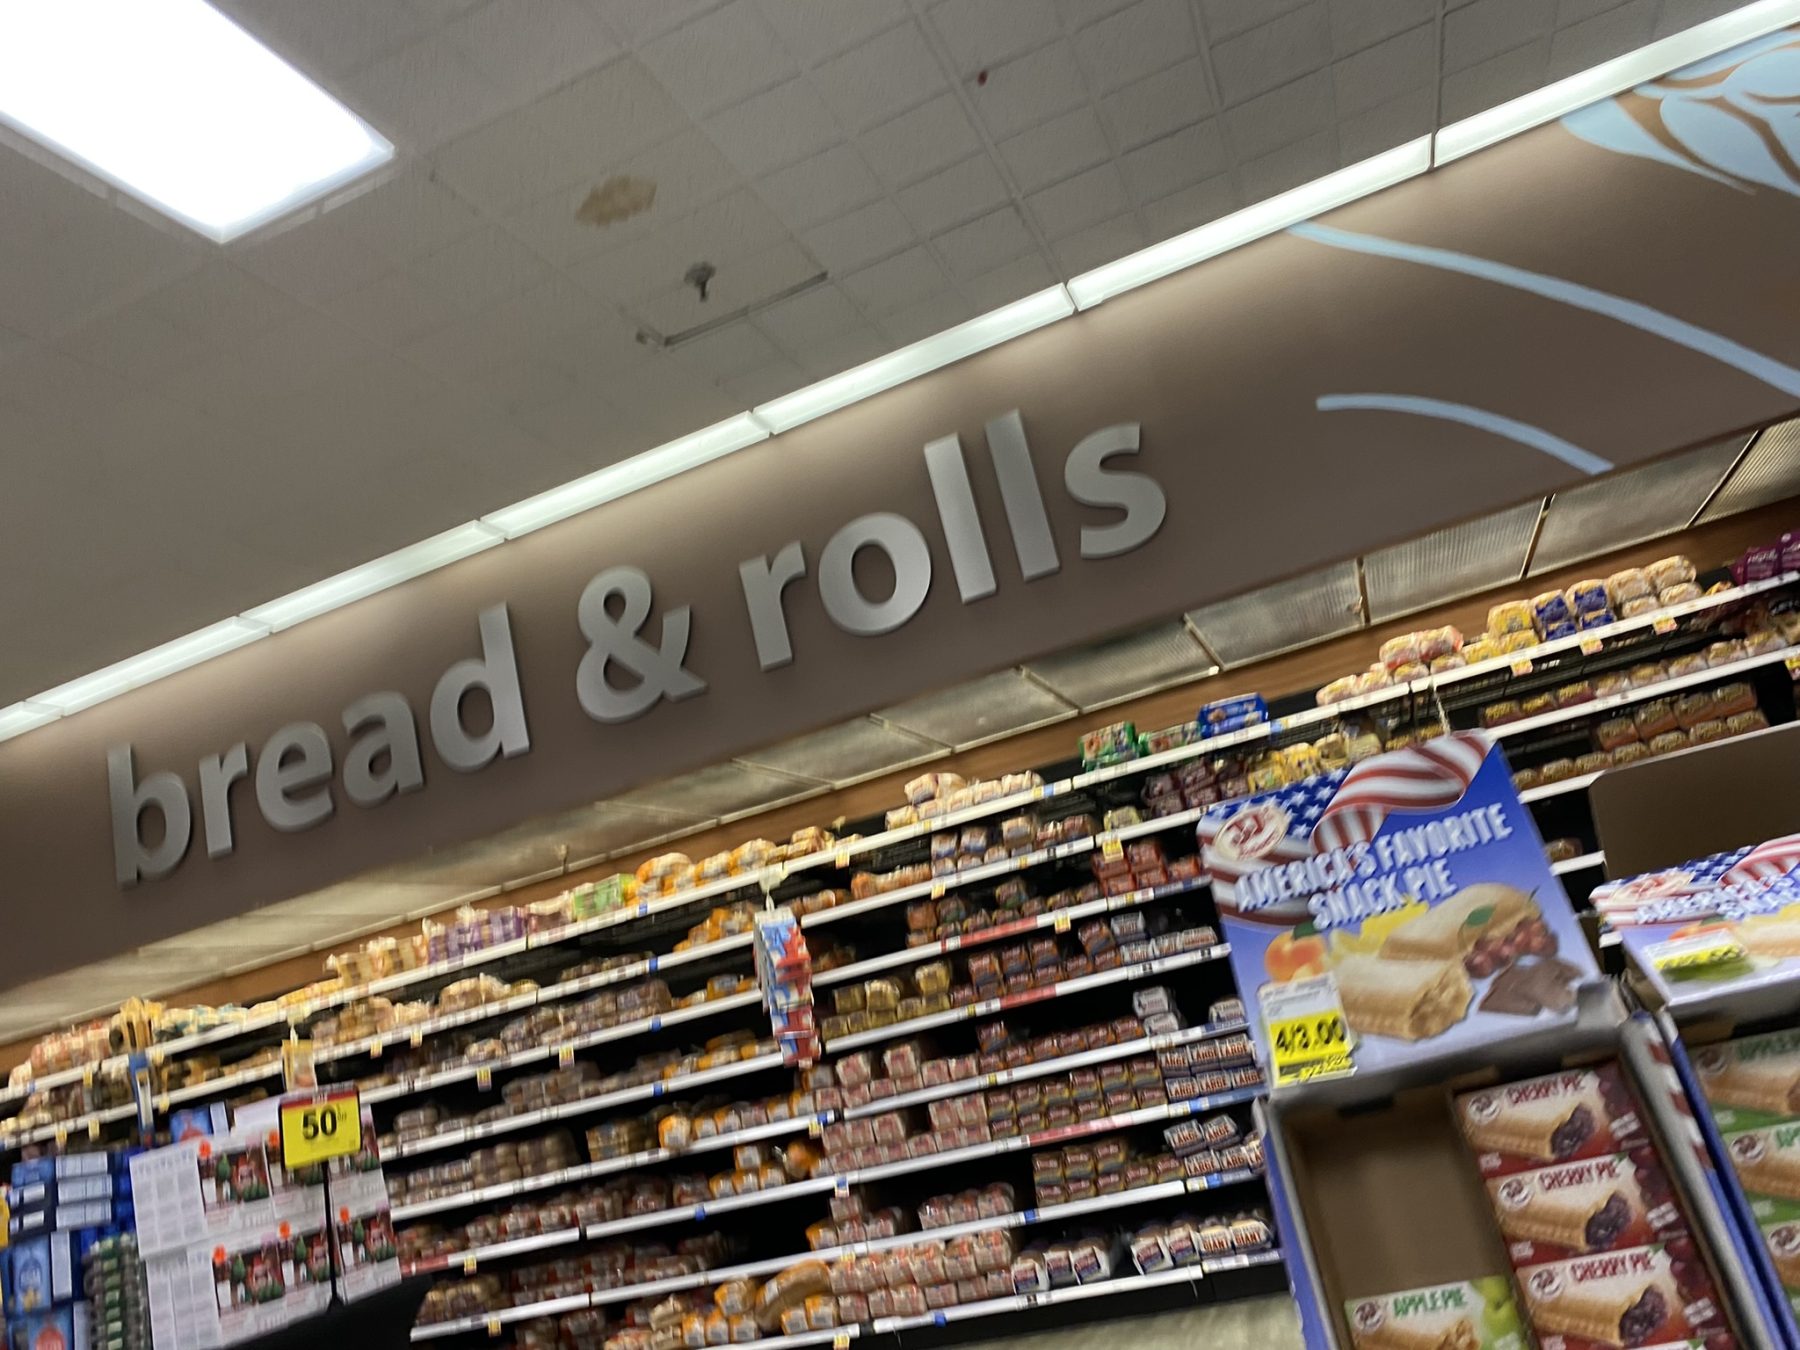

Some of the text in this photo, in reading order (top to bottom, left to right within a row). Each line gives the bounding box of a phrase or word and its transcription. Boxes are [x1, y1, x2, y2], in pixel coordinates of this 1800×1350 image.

[106, 409, 1170, 890] bread & rolls
[1234, 803, 1513, 913] AMERICA'S FAVORITE
[1307, 858, 1457, 931] SNACK PIE
[1505, 1074, 1587, 1104] CHERRY PIE
[1538, 1161, 1621, 1192] CHERRY PIE
[1570, 1252, 1657, 1282] CHERRY PIE
